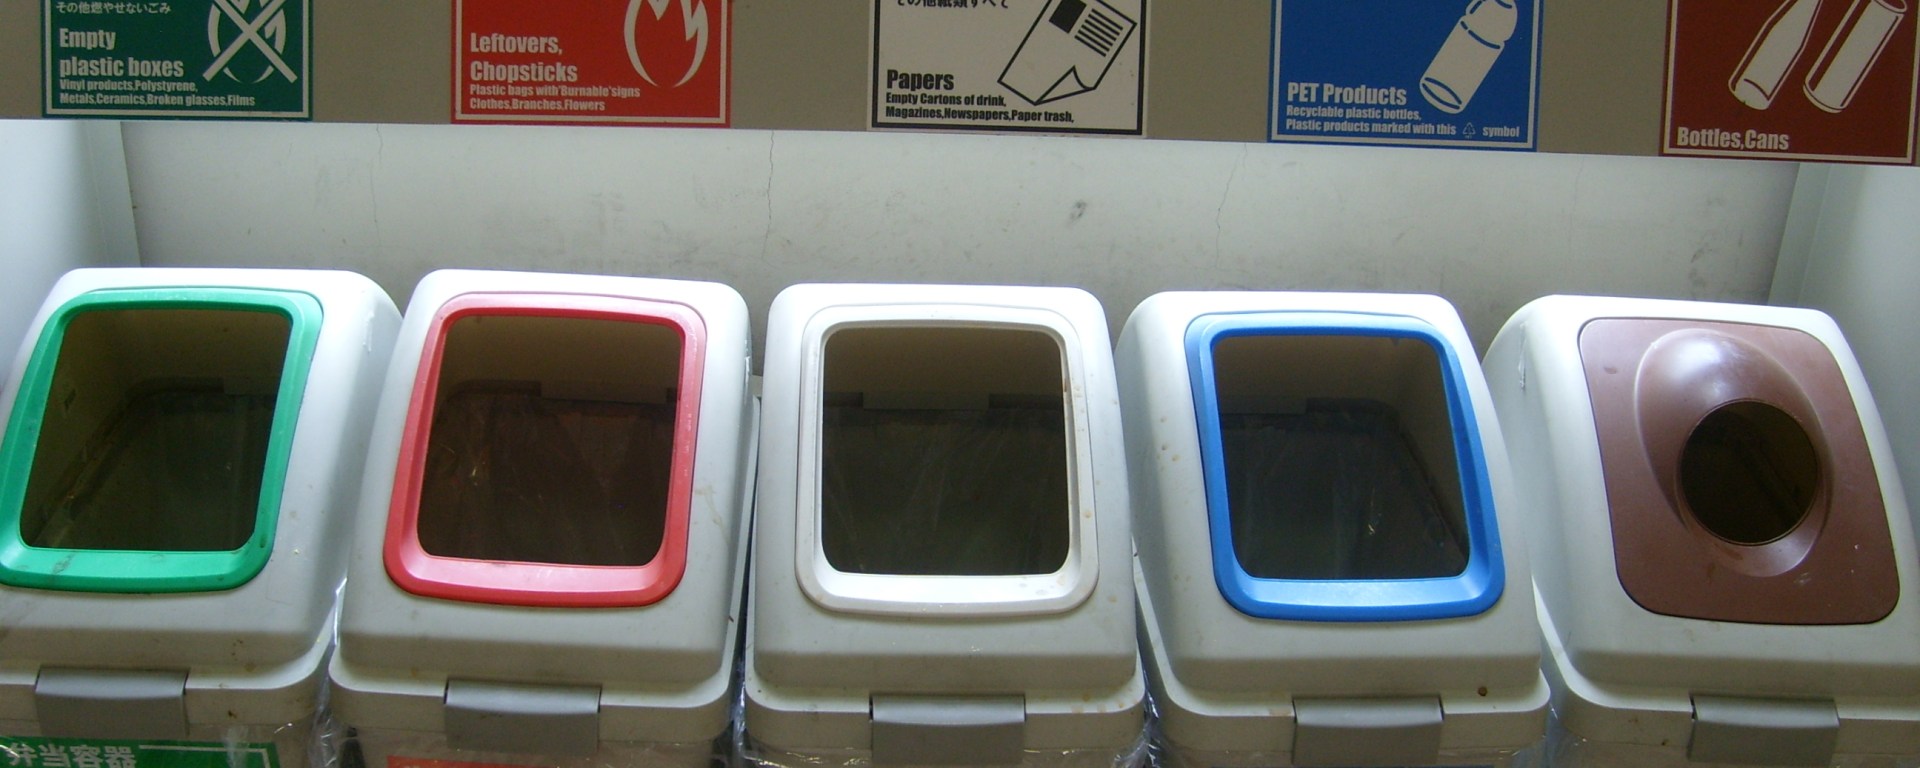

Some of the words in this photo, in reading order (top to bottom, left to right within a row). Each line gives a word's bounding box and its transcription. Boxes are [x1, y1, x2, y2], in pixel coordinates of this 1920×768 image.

[59, 27, 116, 50] Empty
[470, 32, 562, 55] Leftovers,
[59, 56, 124, 78] plastic
[128, 57, 184, 78] boxes
[470, 60, 578, 83] Chopsticks
[60, 79, 86, 91] Vinyl
[470, 84, 506, 96] Plastic
[508, 85, 534, 97] bags
[887, 69, 955, 91] Papers
[886, 92, 918, 105] Empty
[920, 93, 962, 106] Cartons
[964, 94, 976, 106] of
[976, 94, 1007, 107] drink,
[1287, 82, 1319, 102] PET
[1323, 83, 1407, 105] Products
[1044, 110, 1075, 123] trash,
[1286, 105, 1344, 118] Recyclable
[1346, 106, 1381, 120] plastic
[1383, 108, 1422, 121] bottles,
[1286, 119, 1322, 131] Plastic
[1323, 120, 1370, 133] products
[1371, 121, 1410, 134] marked
[1412, 122, 1435, 134] with
[1436, 123, 1456, 135] this
[1482, 125, 1520, 139] symbol
[1677, 126, 1790, 151] Bottles,Cans
[7, 742, 137, 768] 弁当容器
